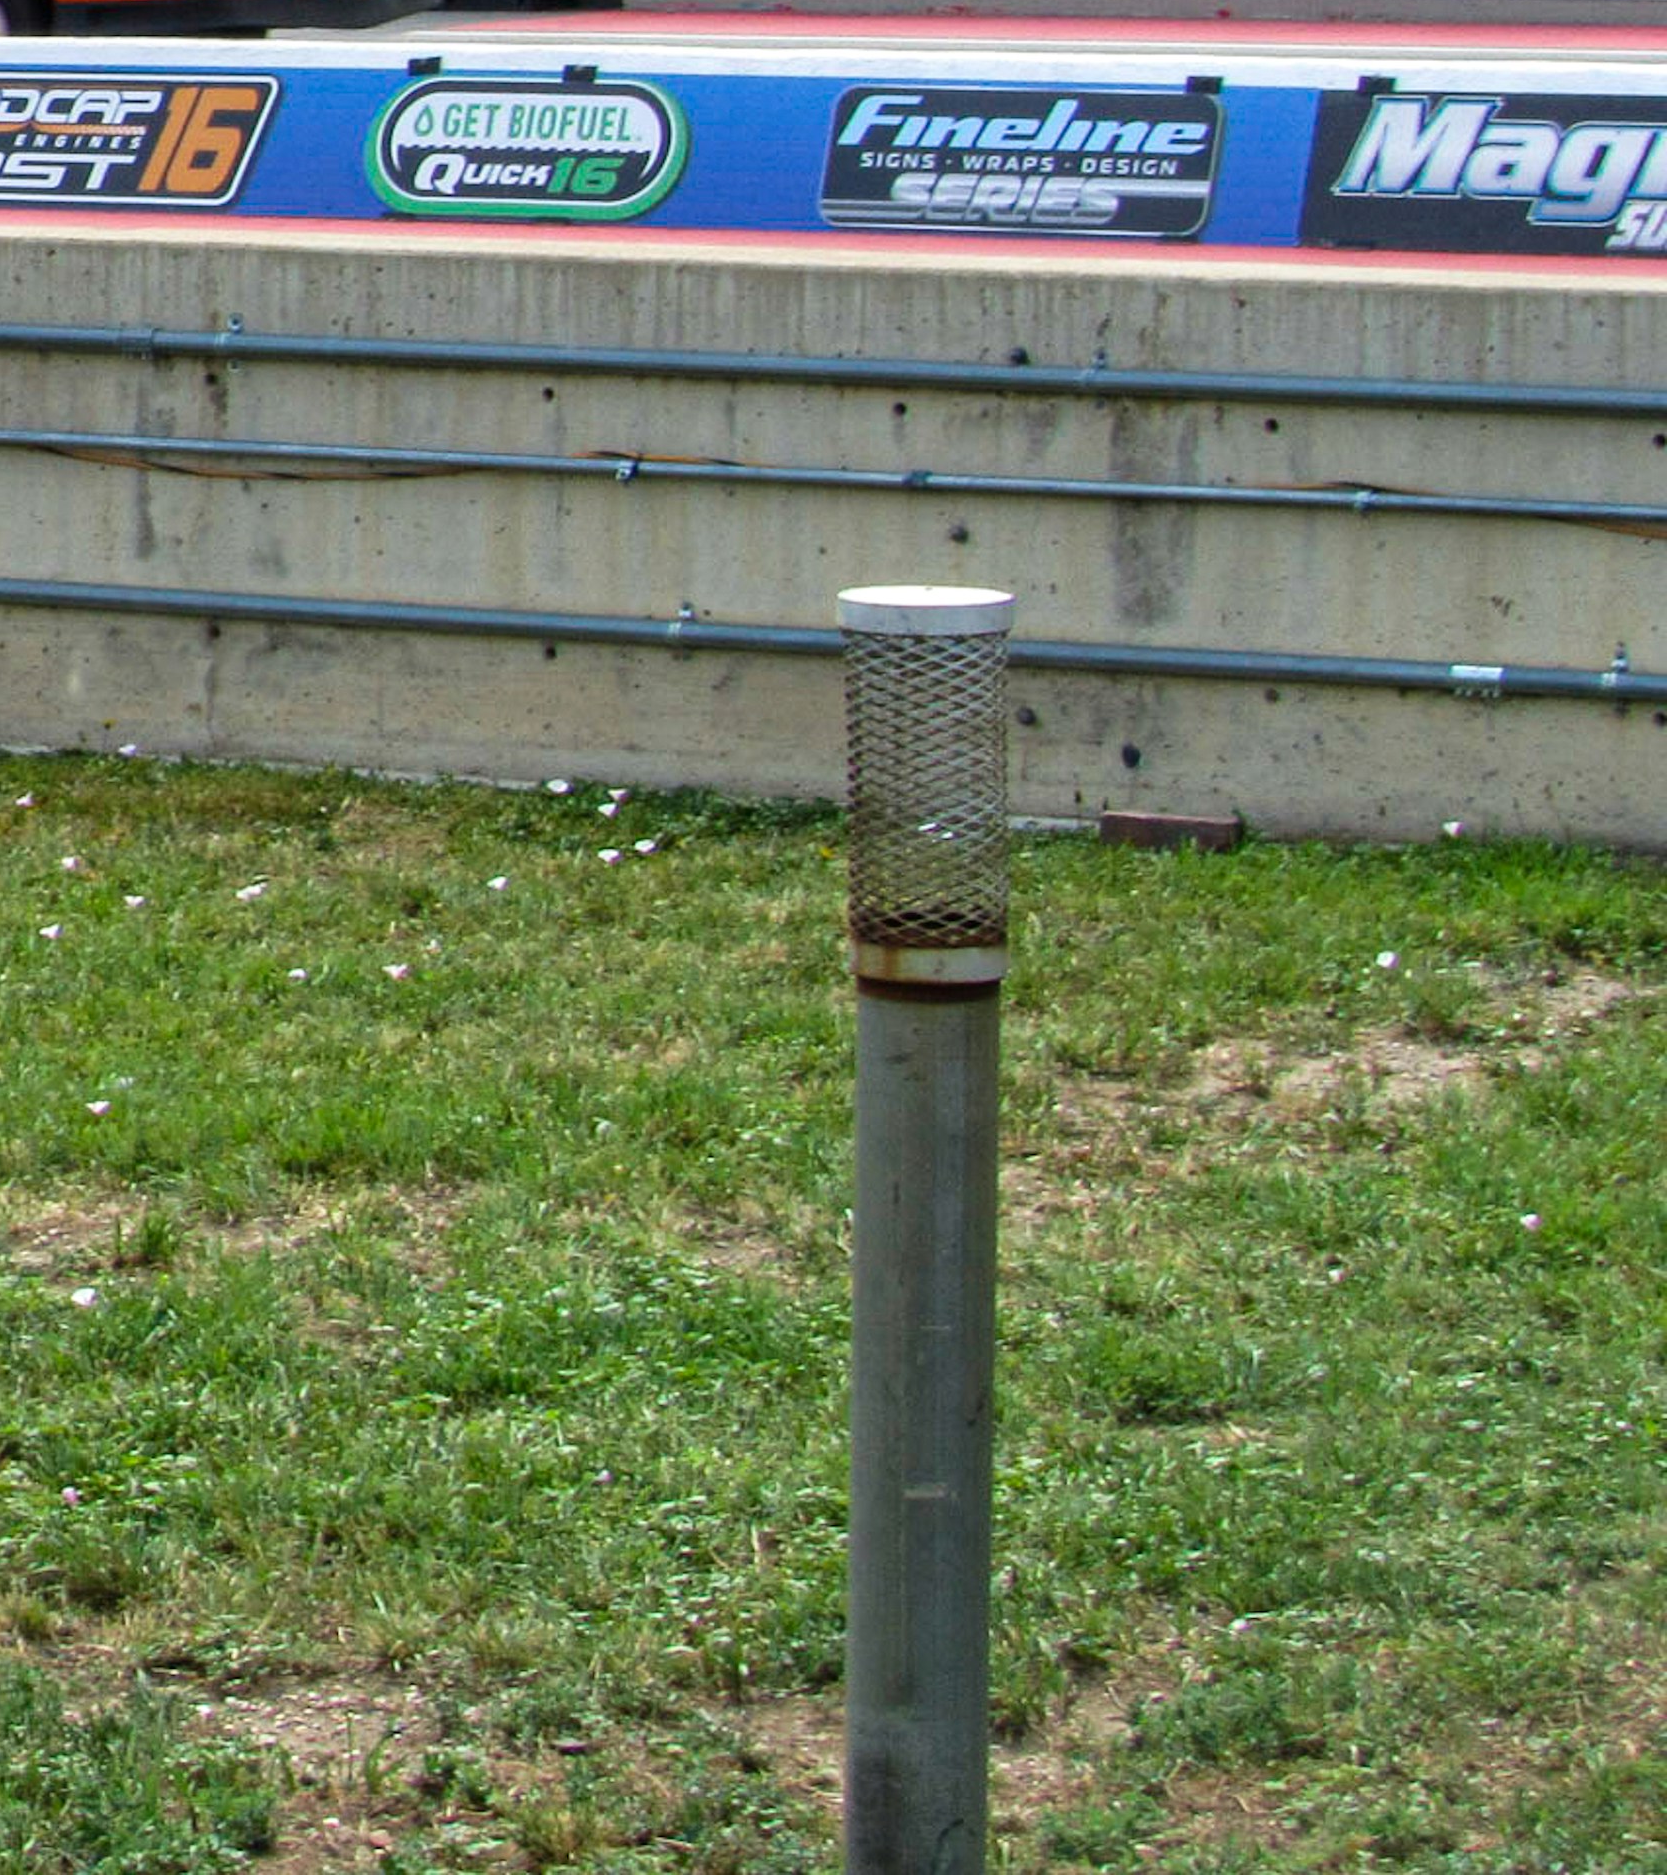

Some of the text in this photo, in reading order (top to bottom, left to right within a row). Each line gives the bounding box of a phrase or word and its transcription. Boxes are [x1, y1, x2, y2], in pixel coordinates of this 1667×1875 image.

[14, 133, 142, 149] ENGINES
[137, 86, 259, 193] 16
[442, 103, 633, 142] GET BIOFUEL
[838, 93, 1209, 155] Fineline
[860, 151, 1178, 176] SIGNS WRAPS DESIGN
[890, 172, 1119, 224] SERIES
